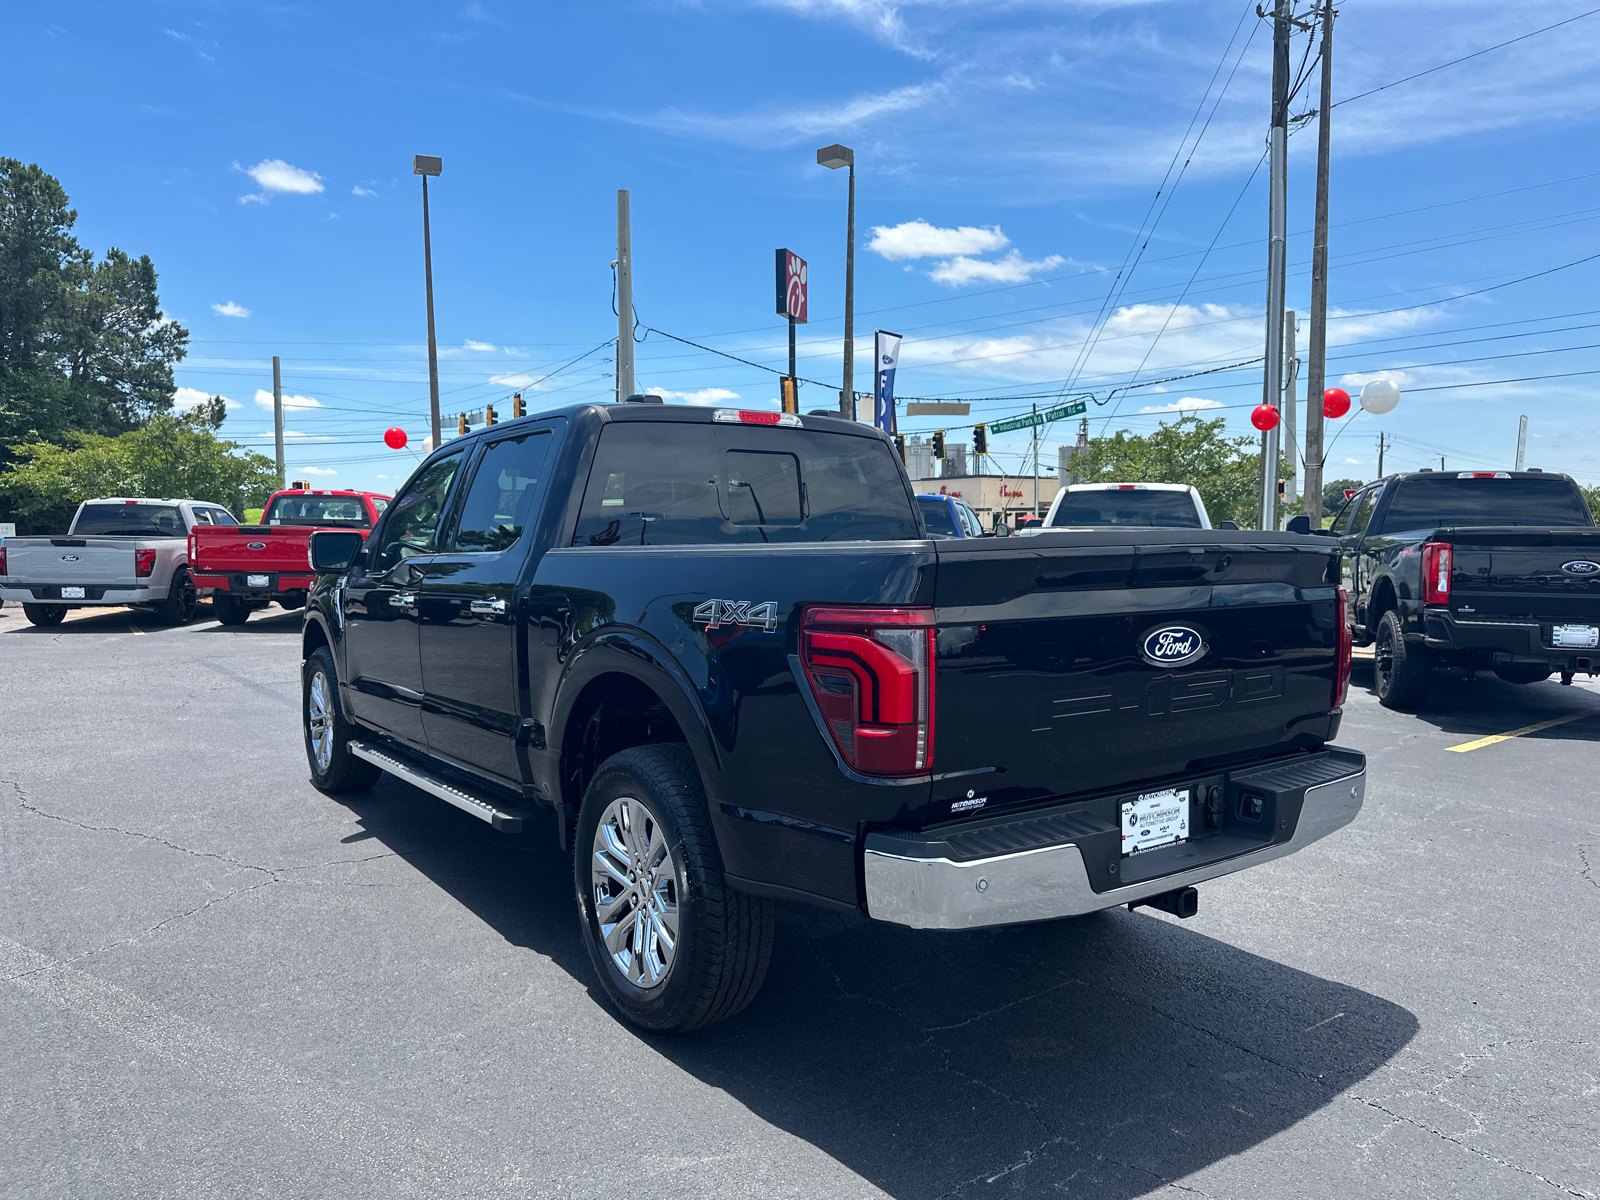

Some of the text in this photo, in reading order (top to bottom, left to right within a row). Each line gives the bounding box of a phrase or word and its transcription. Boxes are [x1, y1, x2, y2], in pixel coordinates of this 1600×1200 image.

[1047, 406, 1076, 420] Patrol Rd
[999, 415, 1042, 431] Industrial Park Rd
[1572, 563, 1593, 572] Ford
[1155, 631, 1193, 656] Ford
[1030, 664, 1286, 733] F-150
[951, 797, 987, 808] HUTCHINSON
[1139, 806, 1181, 823] HUTCHINSON
[1139, 815, 1179, 828] AUTOMOTIVE GROUP
